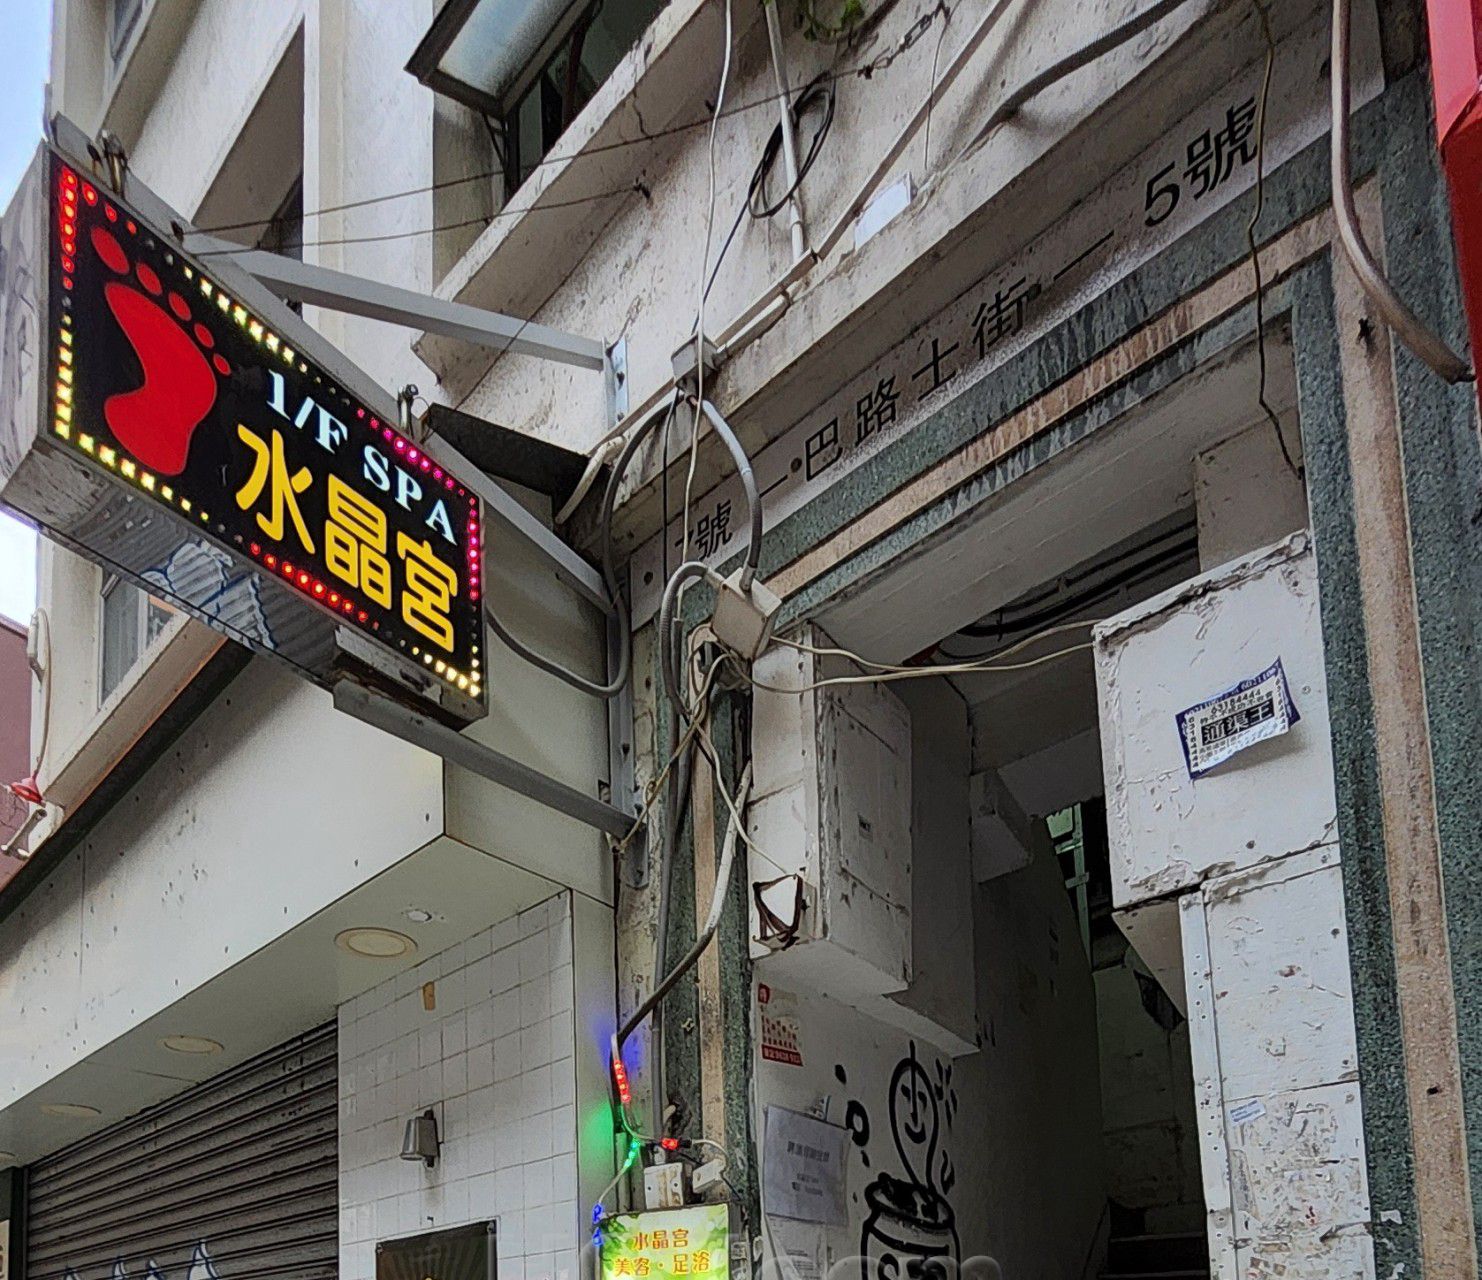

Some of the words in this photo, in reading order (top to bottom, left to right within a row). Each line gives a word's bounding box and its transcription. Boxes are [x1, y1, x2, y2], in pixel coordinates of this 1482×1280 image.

[1144, 97, 1258, 227] 5號
[267, 369, 348, 455] 1/F
[363, 445, 458, 546] SPA
[236, 421, 459, 653] 水晶宮
[1203, 700, 1273, 744] 通渠王
